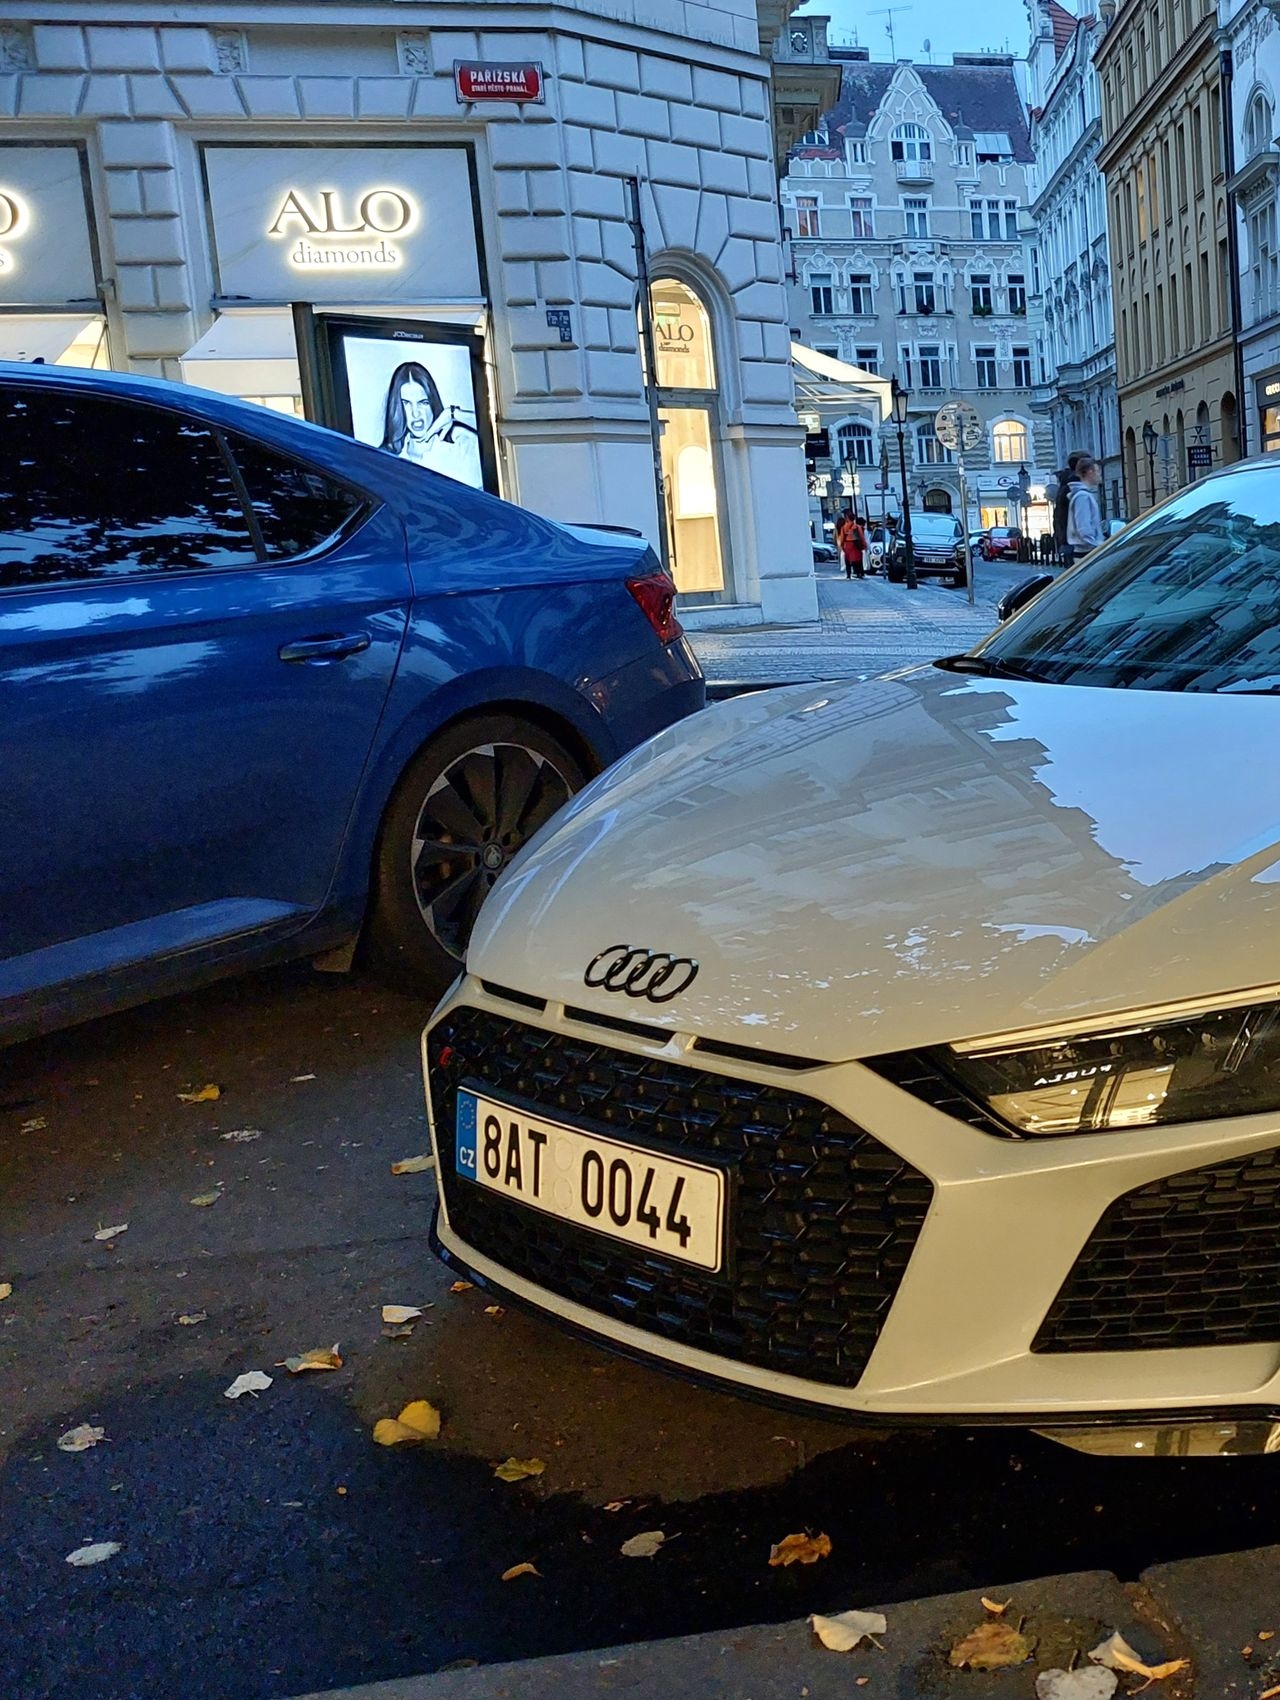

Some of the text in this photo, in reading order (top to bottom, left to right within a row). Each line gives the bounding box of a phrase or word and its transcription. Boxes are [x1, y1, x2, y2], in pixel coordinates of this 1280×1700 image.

[268, 190, 411, 233] ALO
[292, 241, 396, 264] diamonds
[656, 322, 694, 341] ALO
[658, 342, 690, 353] diamonds
[1265, 383, 1280, 396] GUCCI
[459, 1146, 475, 1168] CZ
[484, 1115, 691, 1248] 8AT 0044
